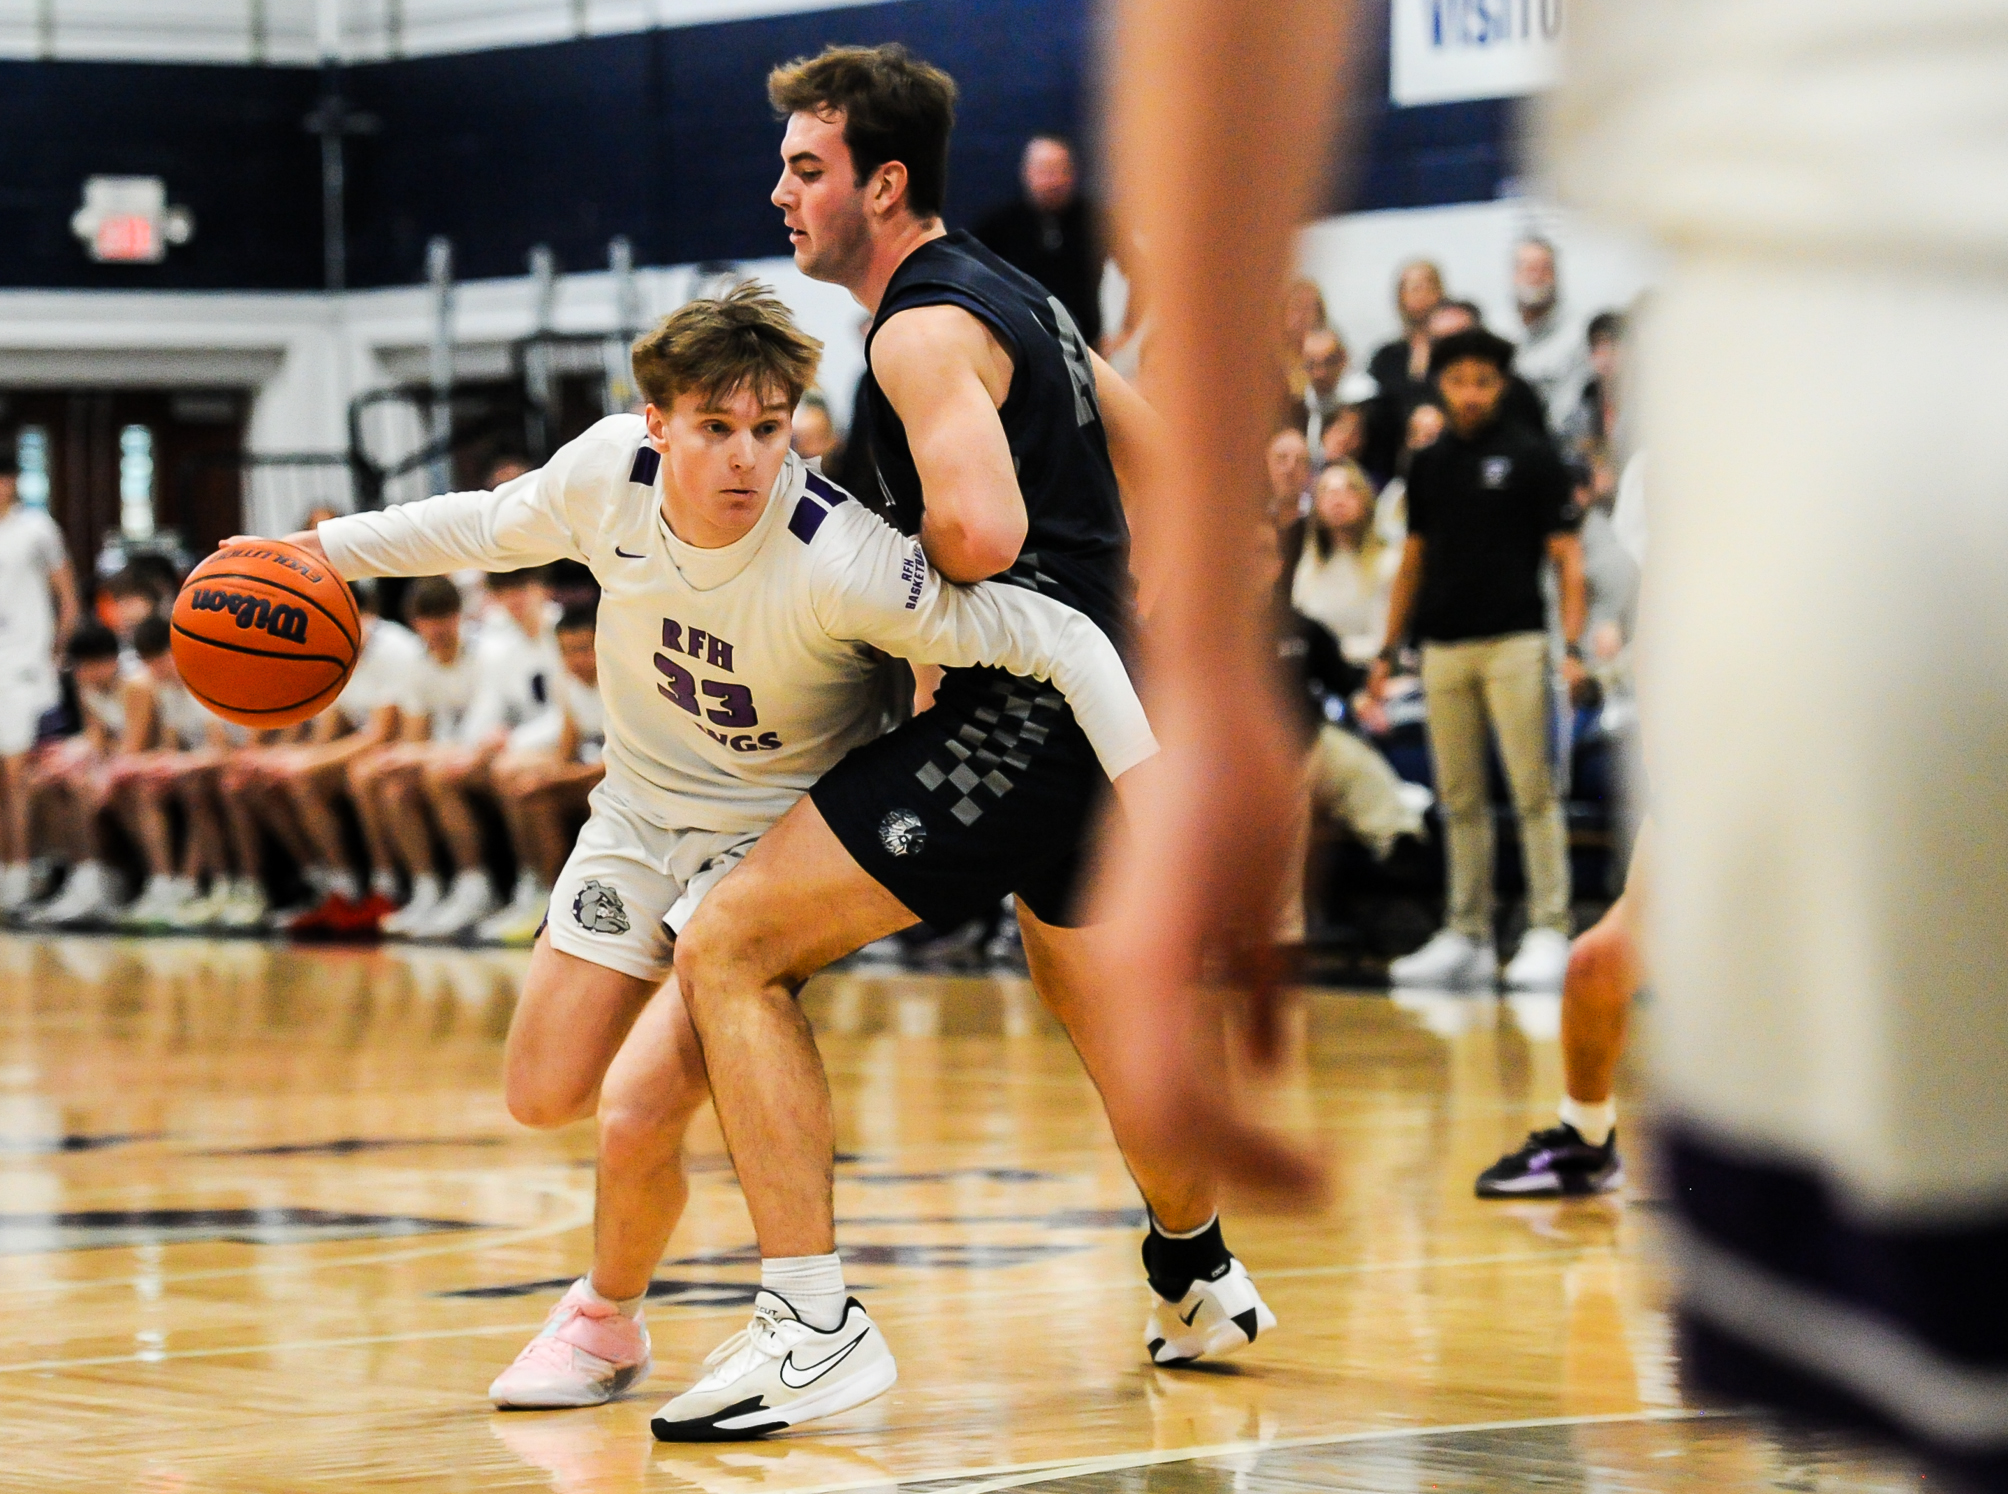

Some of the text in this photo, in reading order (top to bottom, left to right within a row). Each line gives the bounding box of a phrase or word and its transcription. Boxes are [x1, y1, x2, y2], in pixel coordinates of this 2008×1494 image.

[1424, 0, 1563, 46] VISITO
[901, 558, 915, 582] RFH
[191, 588, 309, 645] Wilson
[662, 617, 735, 674] RFH
[653, 651, 758, 729] 33
